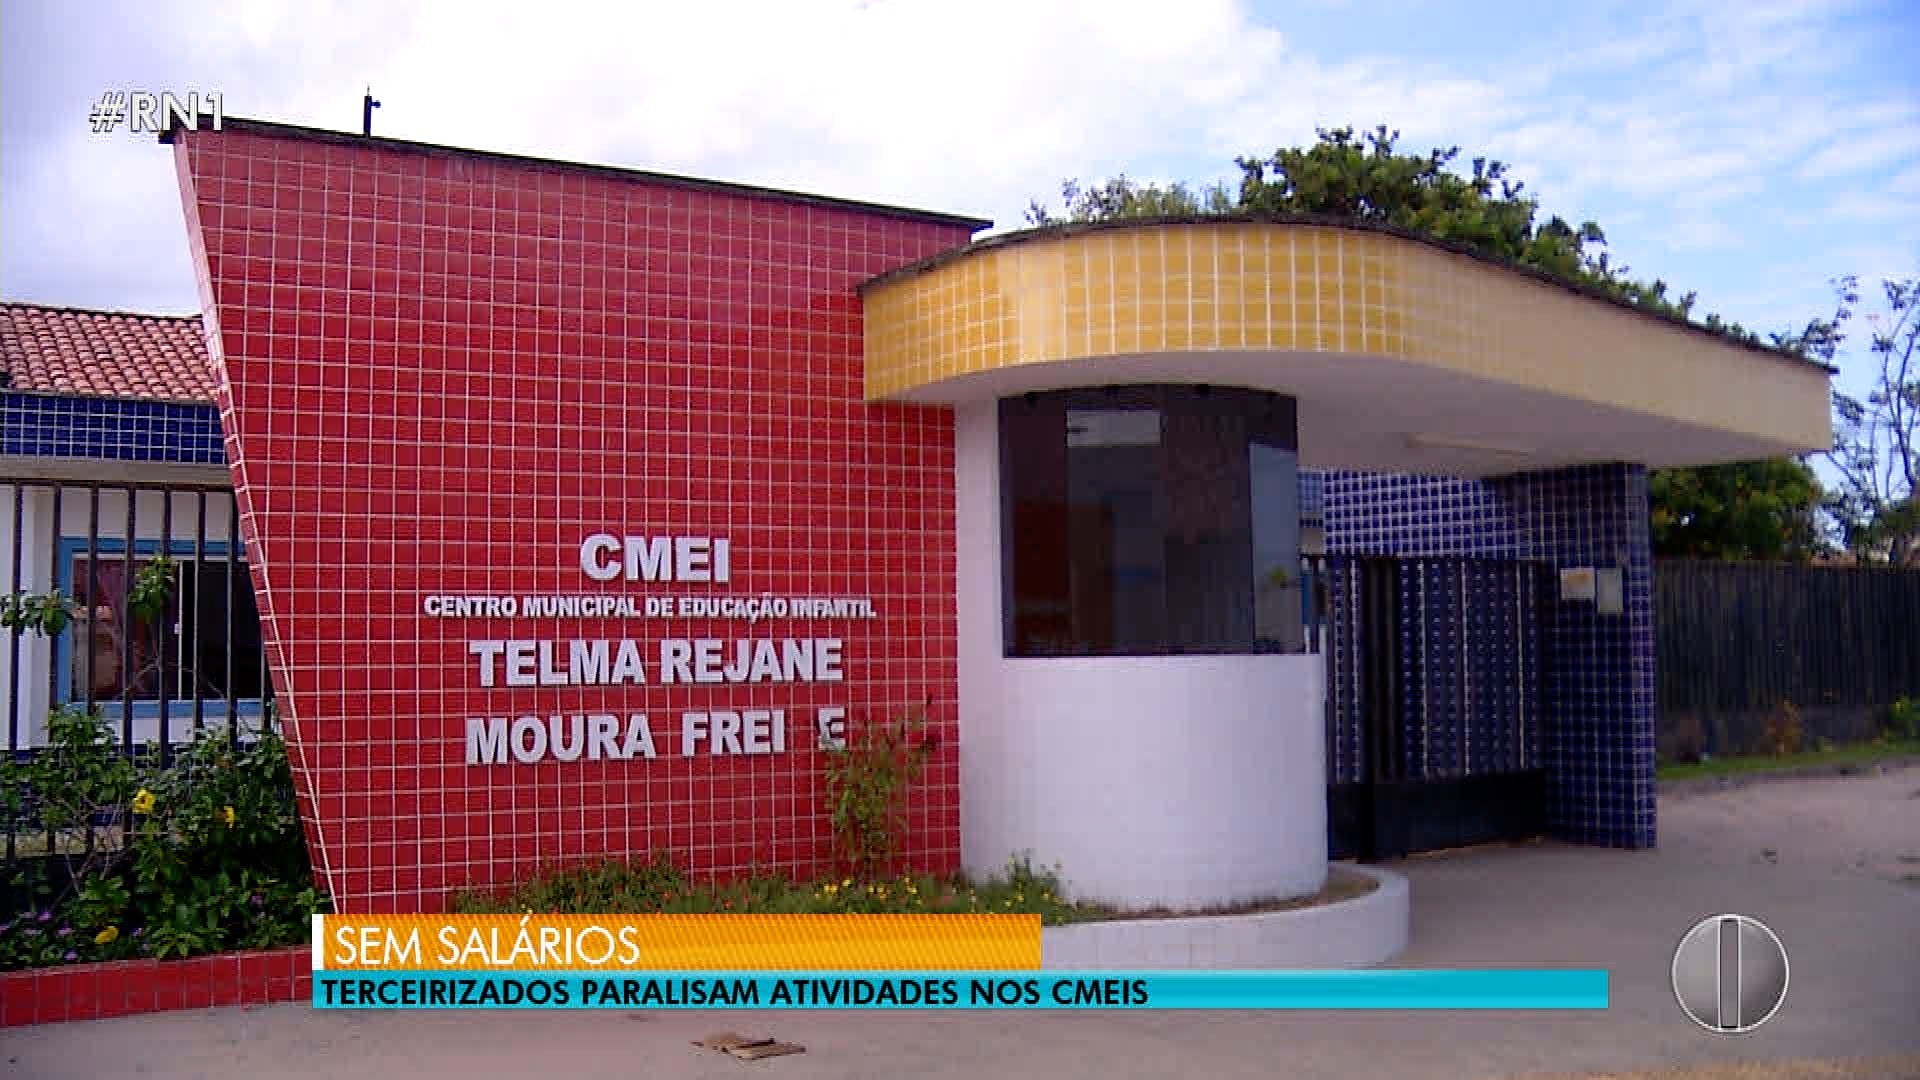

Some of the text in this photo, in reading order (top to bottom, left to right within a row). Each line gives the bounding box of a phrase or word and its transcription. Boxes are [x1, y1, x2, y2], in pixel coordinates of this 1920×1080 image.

[579, 533, 730, 583] CMEI
[424, 593, 877, 624] CENTRO MUNICIPAL DE EDUCAÇÃO INFANTIL
[469, 638, 843, 687] TELMA REJANE
[466, 713, 656, 765] MOURA
